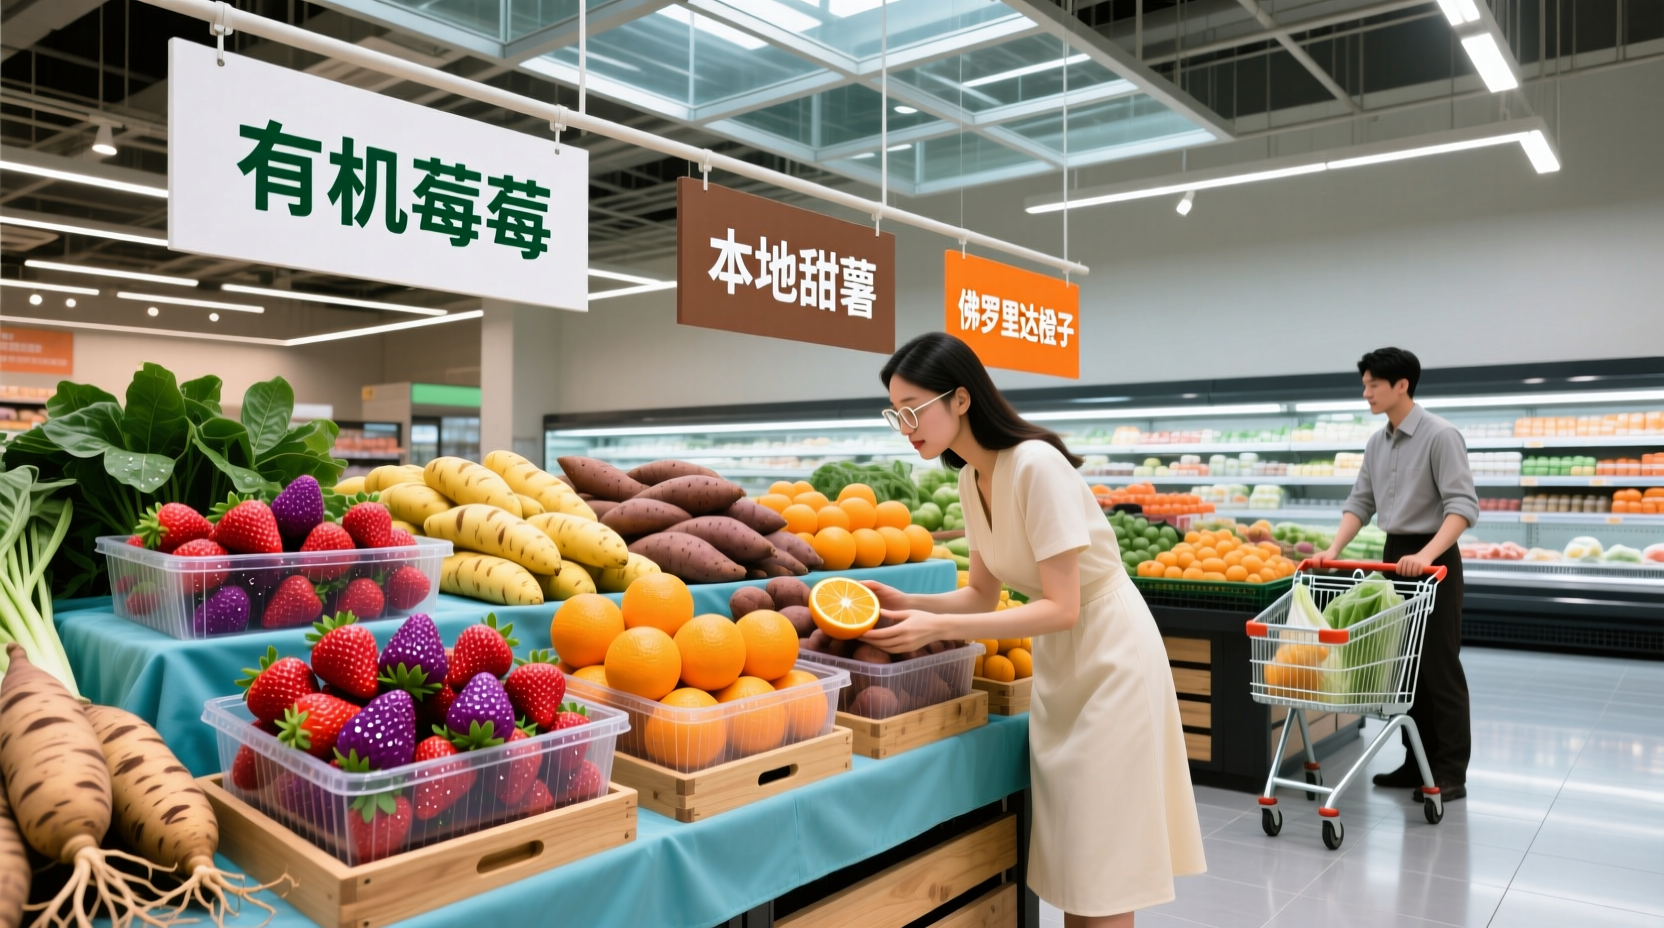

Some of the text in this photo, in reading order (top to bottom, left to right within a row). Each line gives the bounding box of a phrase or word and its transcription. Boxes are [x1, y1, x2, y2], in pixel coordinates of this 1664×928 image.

[237, 119, 551, 260] 有机莓莓
[707, 227, 877, 319] 本地甜薯
[958, 288, 1075, 348] 佛罗里达橙子
